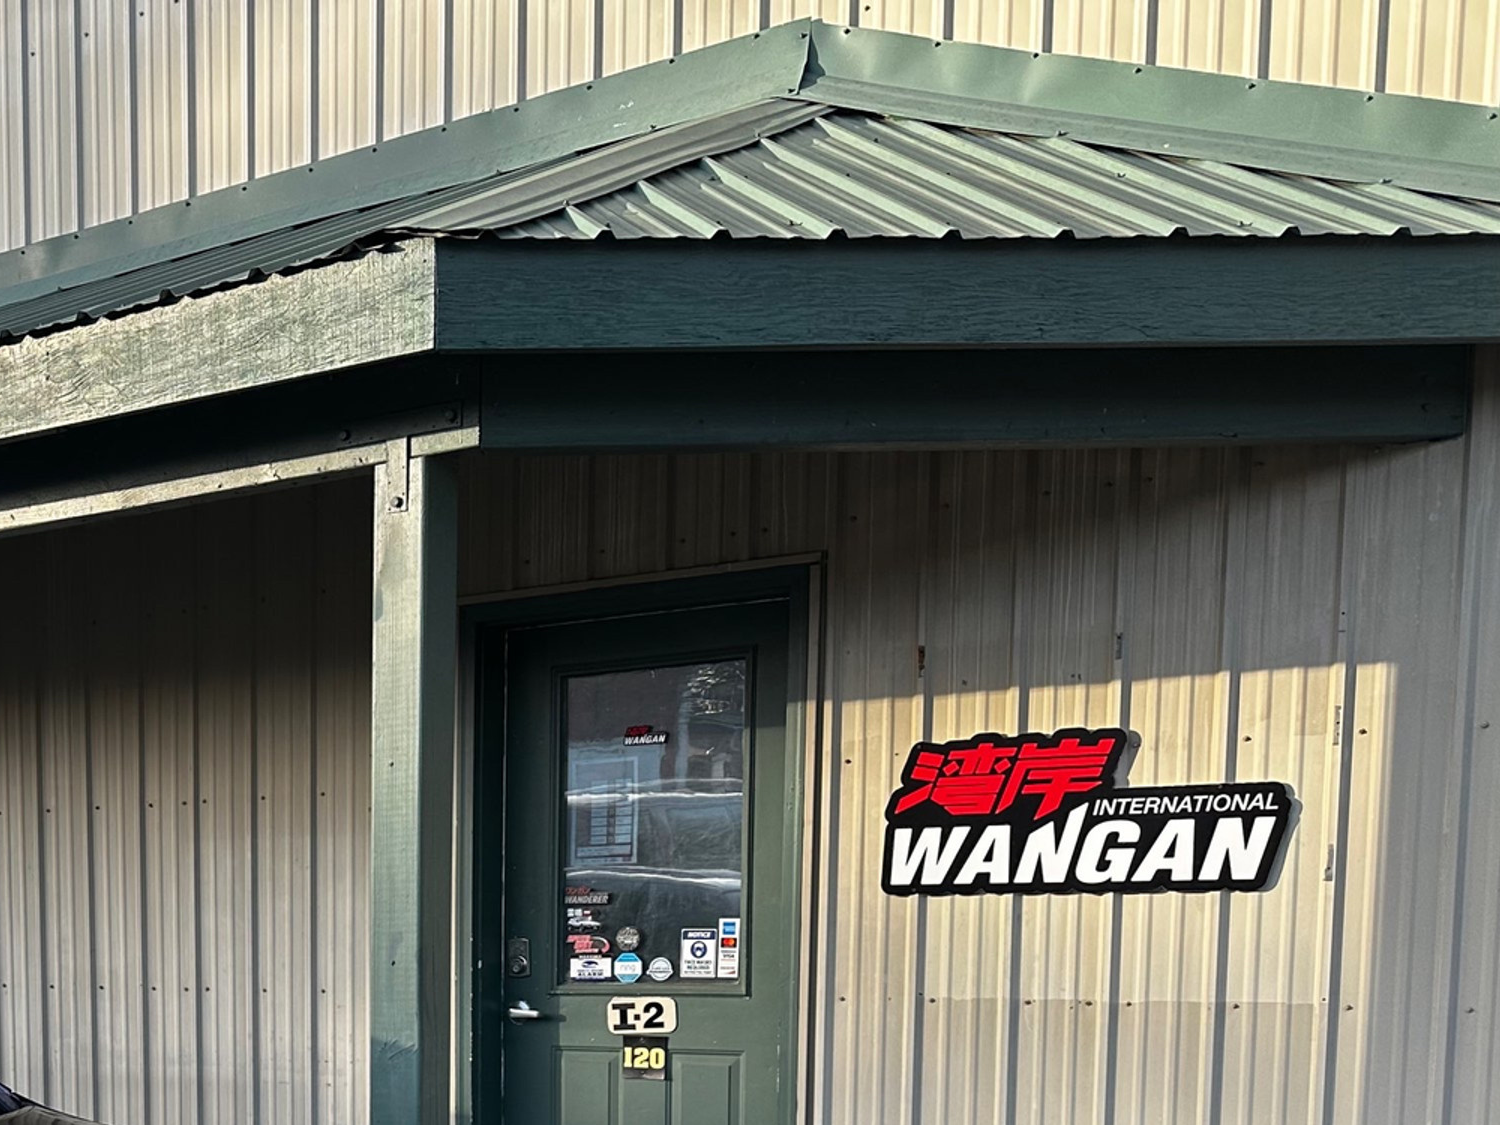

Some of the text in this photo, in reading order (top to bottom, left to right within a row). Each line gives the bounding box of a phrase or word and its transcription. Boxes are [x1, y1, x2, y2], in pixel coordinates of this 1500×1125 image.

[625, 734, 666, 745] WANGAN
[895, 738, 1115, 820] 湾岸
[1093, 793, 1279, 816] INTERNATIONAL
[890, 802, 1276, 885] WANGAN
[623, 1046, 666, 1070] 120
